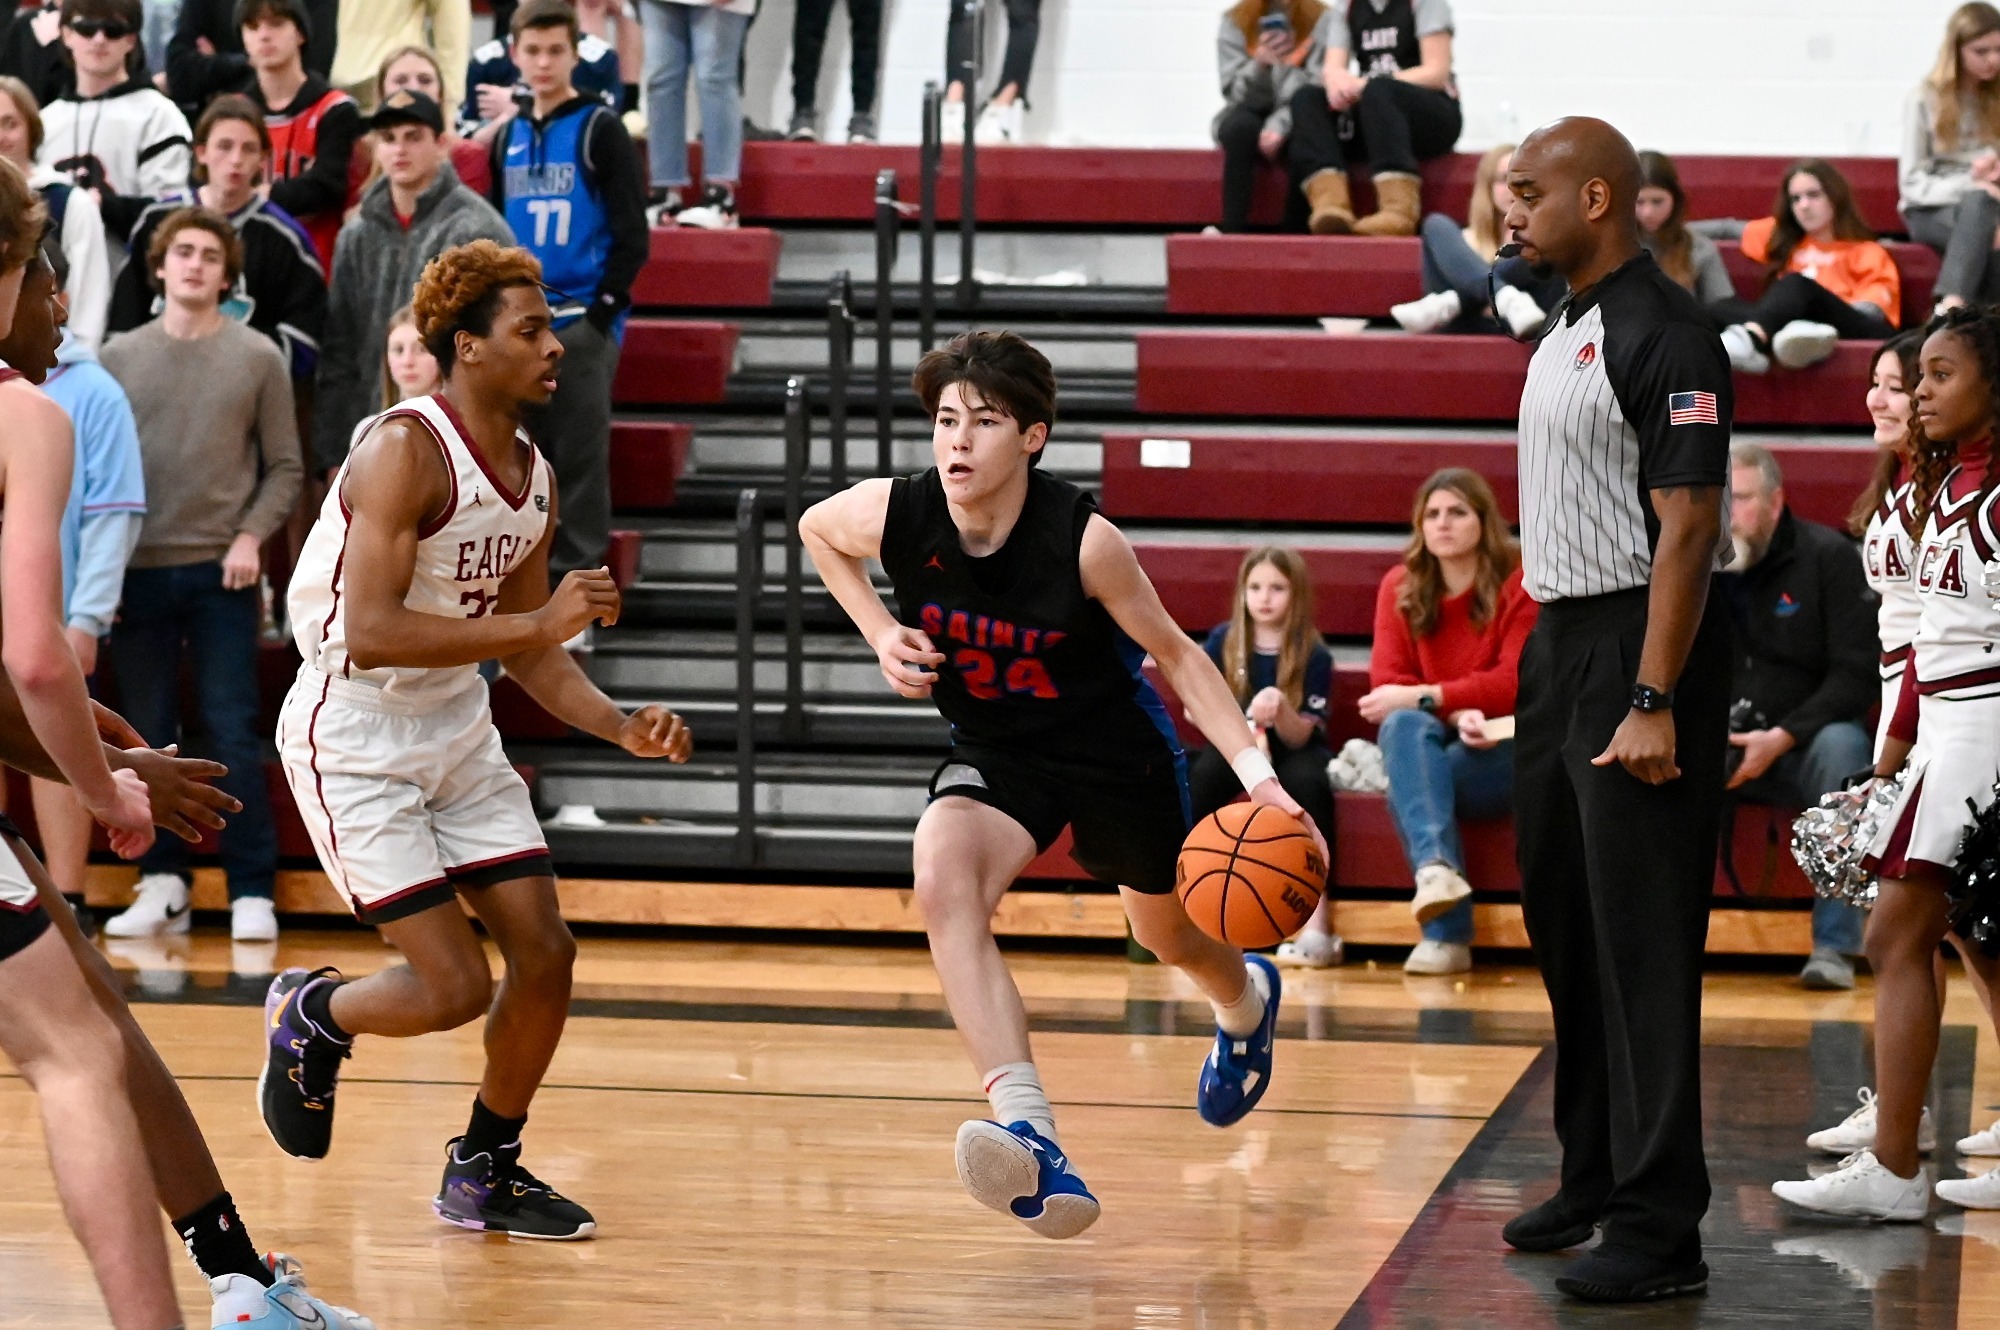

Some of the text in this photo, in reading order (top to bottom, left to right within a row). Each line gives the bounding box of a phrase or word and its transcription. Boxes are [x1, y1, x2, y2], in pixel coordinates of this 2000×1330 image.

[526, 199, 572, 247] 77
[454, 533, 532, 582] EAGL
[1866, 534, 1911, 582] CA
[1919, 541, 1968, 598] CA
[954, 648, 1060, 699] 24
